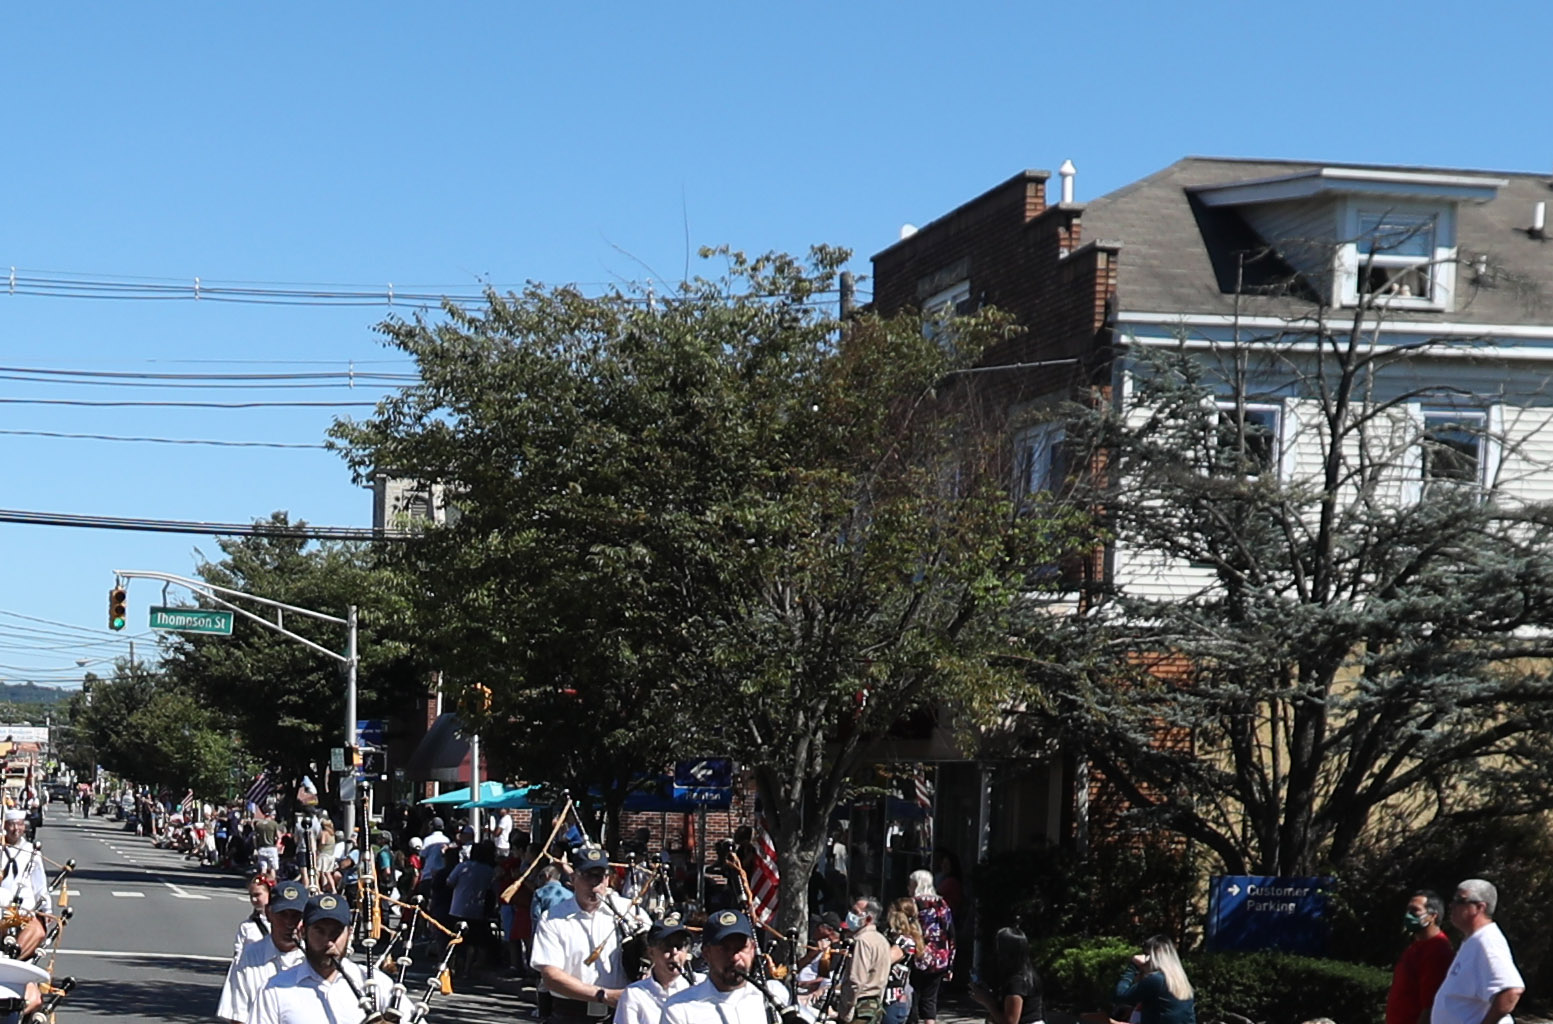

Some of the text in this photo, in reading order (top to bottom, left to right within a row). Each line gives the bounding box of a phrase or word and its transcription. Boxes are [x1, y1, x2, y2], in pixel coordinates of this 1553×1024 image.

[157, 612, 226, 629] Thompson St
[1247, 884, 1310, 897] Customer
[1247, 900, 1296, 914] Parking
